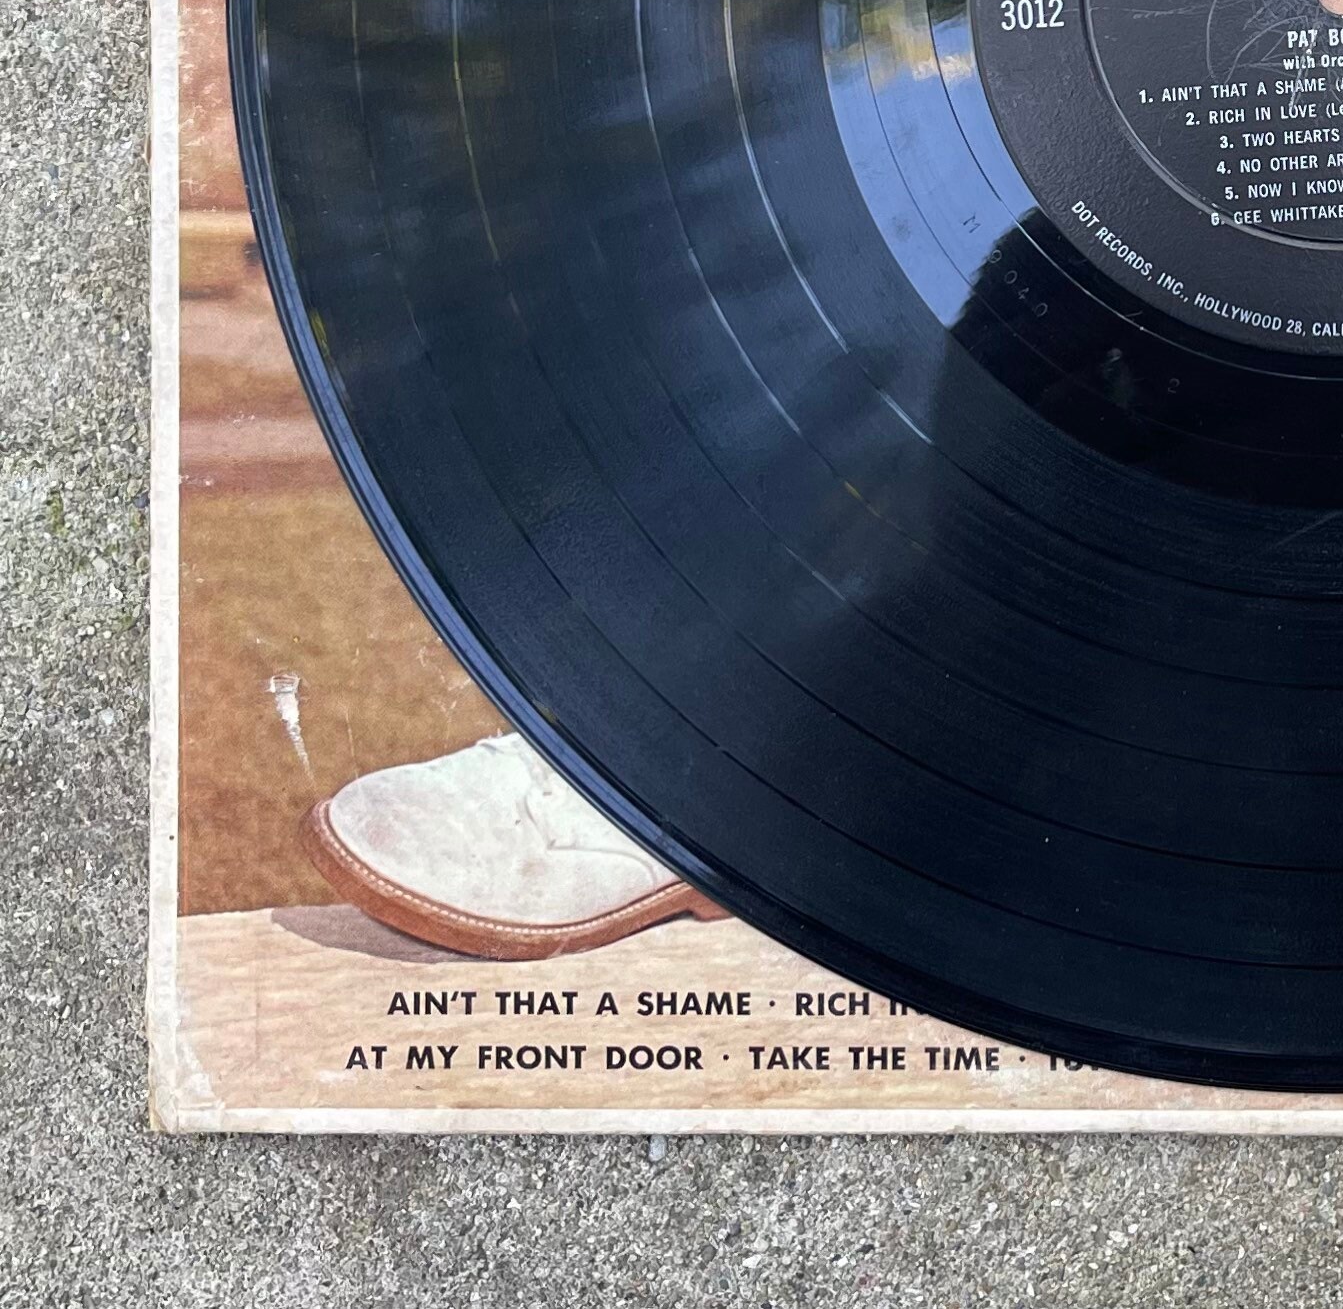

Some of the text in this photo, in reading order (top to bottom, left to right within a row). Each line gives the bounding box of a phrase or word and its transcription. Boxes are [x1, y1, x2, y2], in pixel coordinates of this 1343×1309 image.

[1287, 29, 1318, 49] PAT
[1283, 54, 1316, 71] with
[1138, 89, 1154, 104] 1.
[1161, 85, 1203, 103] AIN'T
[1211, 82, 1248, 99] THAT
[1256, 81, 1267, 96] A
[1275, 77, 1327, 95] SHAME
[1185, 111, 1201, 126] 2.
[1209, 108, 1246, 125] RICH
[1255, 106, 1271, 121] IN
[1280, 103, 1317, 119] LOVE
[1219, 135, 1235, 149] 3.
[1242, 132, 1276, 148] TWO
[1284, 128, 1341, 145] HEARTS
[1216, 161, 1232, 175] 4.
[1239, 159, 1262, 173] NO
[1269, 155, 1319, 171] OTHER
[1224, 186, 1240, 200] 5.
[1247, 183, 1283, 199] NOW
[1291, 181, 1297, 196] I
[1233, 209, 1262, 225] GEE
[1071, 200, 1100, 228] DOT
[1095, 226, 1153, 281] RECORDS,
[1156, 272, 1189, 303] INC.,
[1193, 292, 1283, 331] HOLLYWOOD
[1286, 318, 1307, 337] 28,
[387, 991, 477, 1016] AIN'T
[495, 991, 579, 1016] THAT
[595, 991, 619, 1016] A
[636, 991, 752, 1016] SHAME
[795, 992, 870, 1016] RICH
[345, 1044, 1000, 1071] AT MY FRONT DOOR TAKE THE TIME
